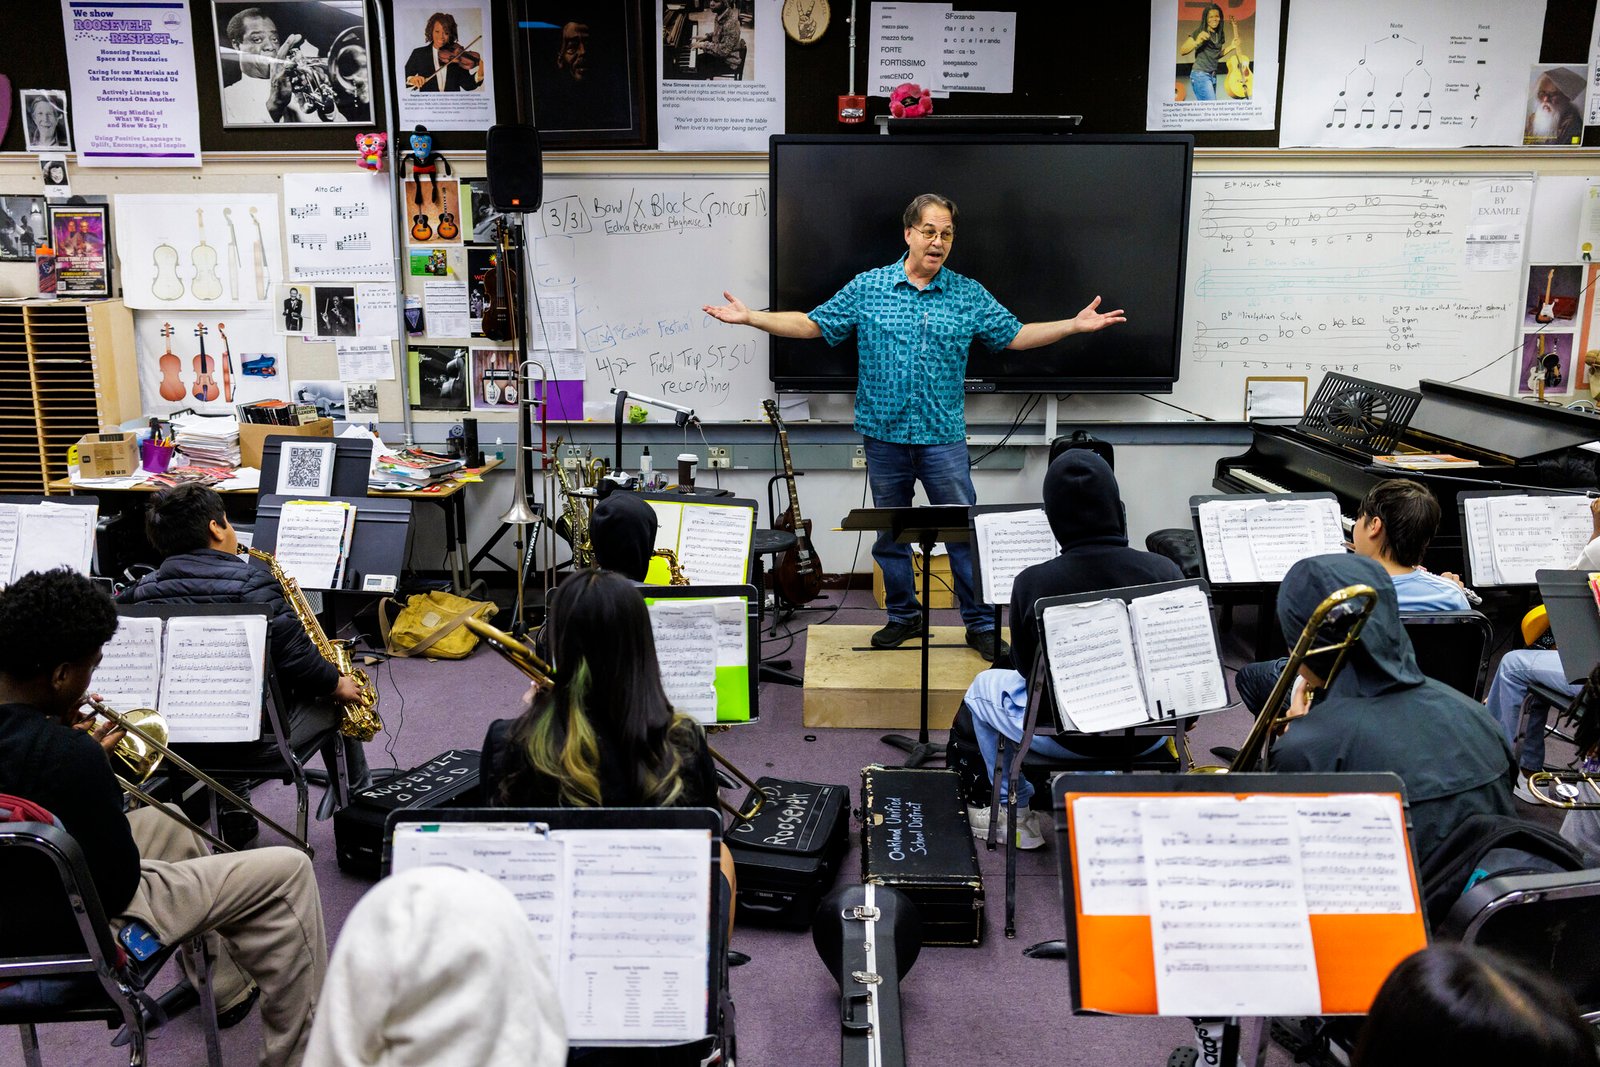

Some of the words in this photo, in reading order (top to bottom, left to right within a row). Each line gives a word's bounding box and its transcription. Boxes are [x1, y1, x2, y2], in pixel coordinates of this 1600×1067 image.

[74, 20, 152, 30] ROOSEVELT
[110, 33, 170, 44] RESPECT
[650, 192, 697, 217] Block
[1280, 312, 1302, 321] Scale
[661, 377, 730, 407] recording
[362, 751, 461, 798] ROOSEVELT
[763, 793, 811, 844] Roosevelt
[884, 797, 902, 824] Unified
[905, 802, 923, 828] District
[888, 829, 905, 860] Oakland
[909, 830, 927, 855] School
